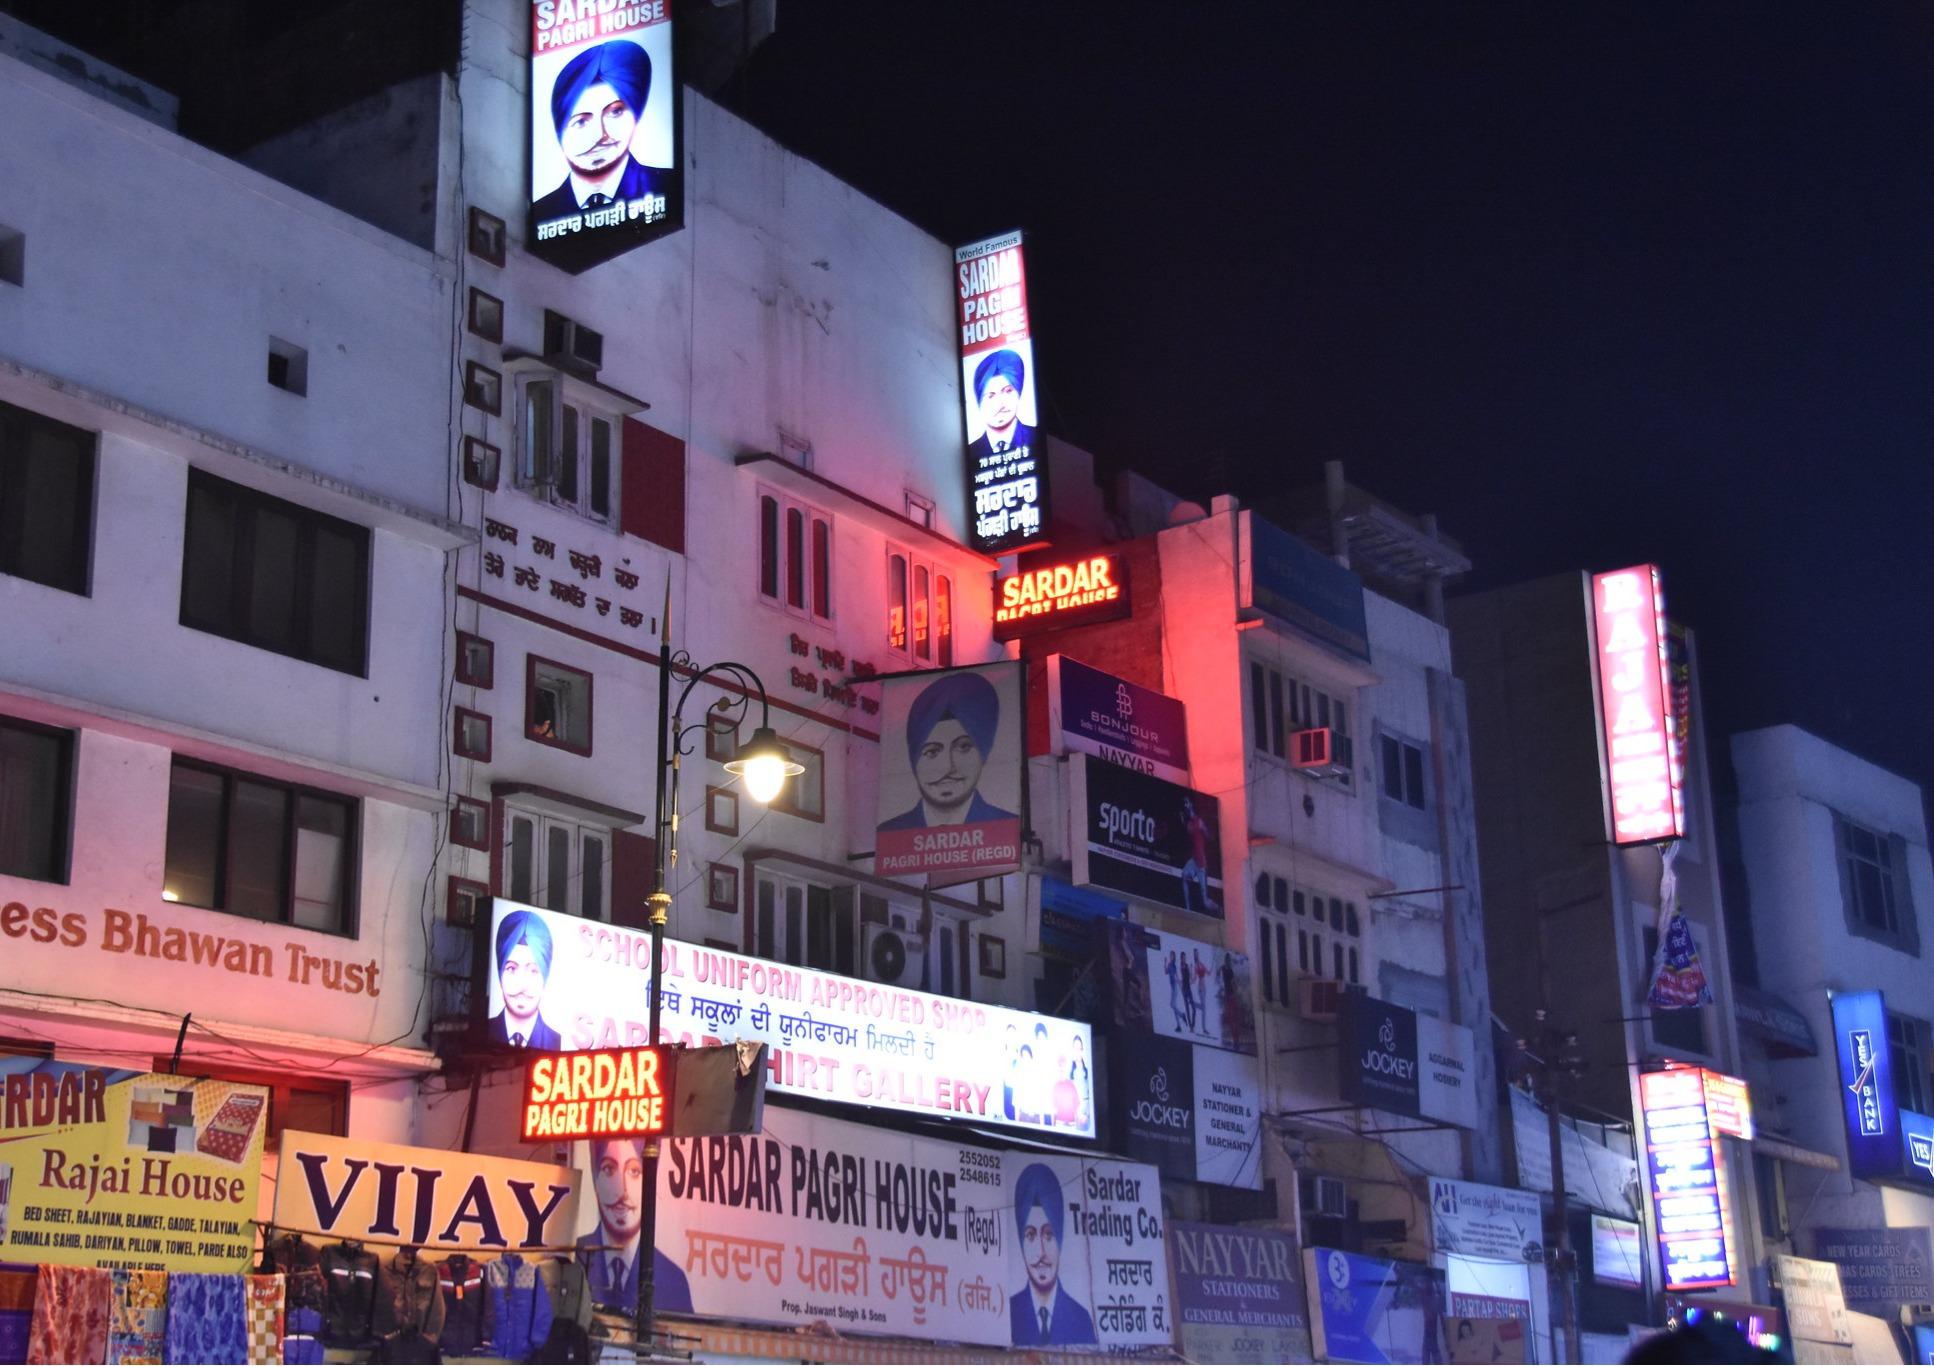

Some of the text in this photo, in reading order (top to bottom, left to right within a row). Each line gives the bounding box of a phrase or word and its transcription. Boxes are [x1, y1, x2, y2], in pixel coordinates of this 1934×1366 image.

[537, 1, 664, 51] PAGRI HOUSE
[959, 237, 1018, 260] World Famous
[960, 248, 1021, 299] SARDAR
[962, 307, 1026, 346] HOUSE
[974, 477, 1037, 514] ਸਰਦਾਰ
[1003, 557, 1111, 608] SARDAR
[1090, 711, 1159, 743] BONJOUR
[1099, 744, 1156, 777] NAYYAR
[883, 845, 1016, 869] PAGRI HOUSE (REGD)
[914, 829, 984, 851] SARDAR
[100, 908, 273, 977] Bhawan
[285, 942, 381, 998] Trust
[578, 924, 987, 1036] SCHOOL UNIFORM APPROVED SHOP
[691, 997, 743, 1032] ਸਕੂਲਾਂ
[750, 1002, 772, 1032] ਦੀ
[779, 1010, 859, 1048] ਯੂਨੀਫਾਰਮ
[866, 1023, 917, 1057] ਮਿਲਦੀ
[1361, 1048, 1414, 1080] JOCKEY
[1855, 1034, 1868, 1068] YES
[531, 1049, 660, 1102] SARDAR
[852, 1063, 993, 1117] GALLERY
[1212, 1082, 1242, 1098] NAYYAR
[525, 1096, 663, 1137] PAGRI HOUSE
[1130, 1100, 1190, 1129] JOCKEY
[1203, 1098, 1244, 1117] STATIONER
[1862, 1085, 1877, 1131] BANK
[1210, 1118, 1245, 1135] GENERAL
[959, 1150, 1001, 1170] 2552052
[1912, 1141, 1930, 1161] YES
[39, 1148, 246, 1205] Rajai House
[959, 1167, 1001, 1188] 2548615
[1087, 1166, 1141, 1203] Sardar
[295, 1151, 571, 1253] VIJAY
[668, 1134, 1001, 1257] SARDAR PAGRI HOUSE (Regd.)
[24, 1206, 42, 1221] BED
[76, 1210, 124, 1228] RAJAYIAN,
[126, 1213, 165, 1231] BLANKET,
[200, 1218, 240, 1236] TALAYIAN,
[1069, 1203, 1163, 1247] Trading Co.
[11, 1230, 50, 1247] RUMALA
[53, 1232, 82, 1250] SAHIB,
[128, 1238, 163, 1255] PILLOW,
[165, 1240, 196, 1256] TOWEL,
[198, 1242, 225, 1258] PARDE
[226, 1244, 248, 1259] ALSO
[1175, 1230, 1295, 1283] NAYYAR
[1848, 1245, 1871, 1258] YEAR
[1872, 1245, 1900, 1258] CARDS
[685, 1229, 1005, 1325] ਸਰਦਾਰ ਪਗੜੀ ਹਾਊਸ (ਰਜਿ.)
[1106, 1259, 1152, 1286] ਸਰਦਾਰ
[1201, 1279, 1280, 1300] STATIONERS
[781, 1299, 887, 1323] Prop. Jaswant Singh & Sons
[1097, 1294, 1146, 1333] ਟਰੇਡਿੰਗ
[1184, 1307, 1304, 1327] GENERAL MERCHANTS
